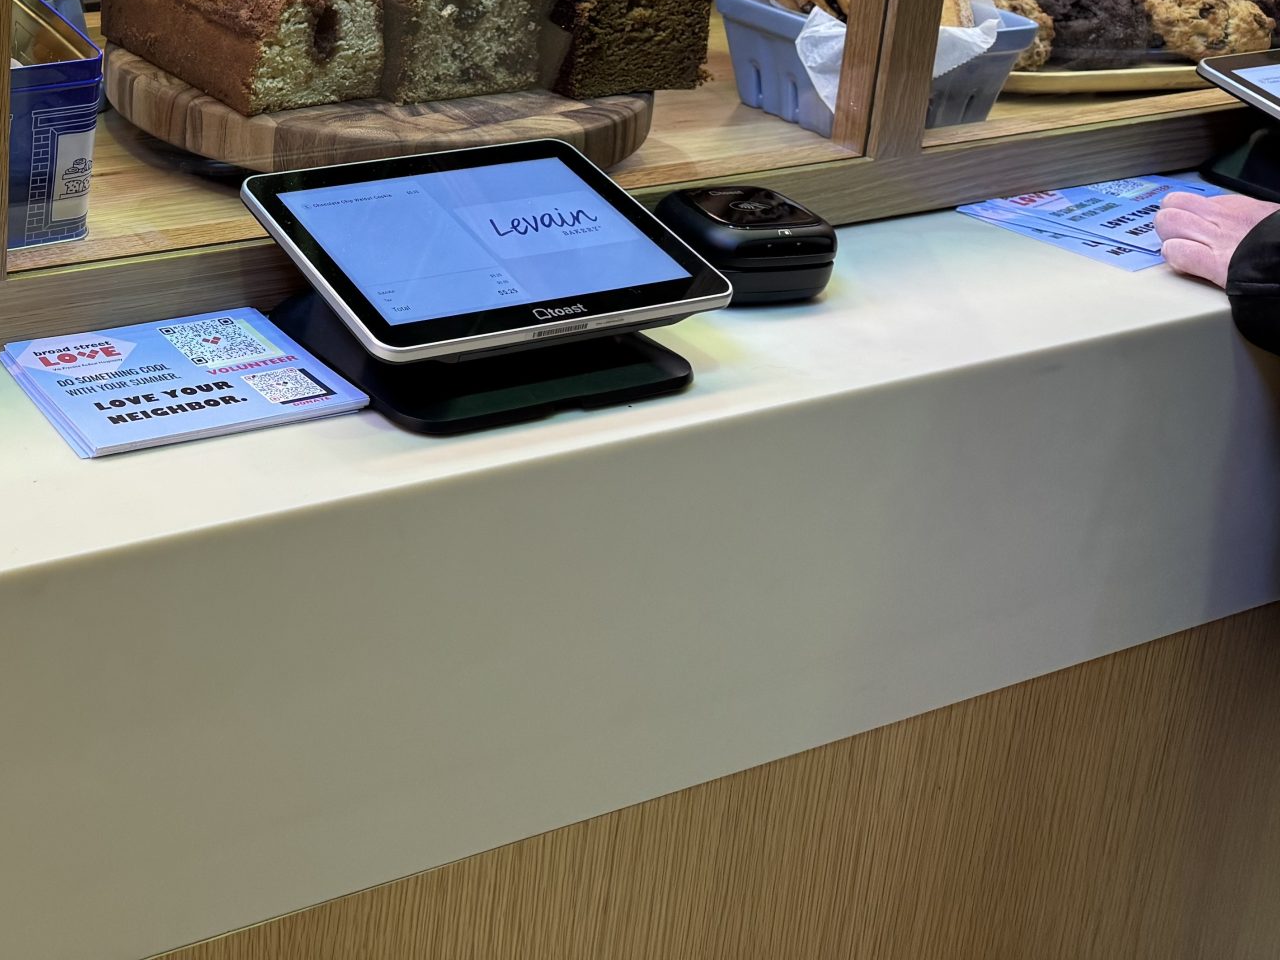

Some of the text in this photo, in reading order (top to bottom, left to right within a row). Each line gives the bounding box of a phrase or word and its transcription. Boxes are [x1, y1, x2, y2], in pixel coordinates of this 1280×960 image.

[489, 207, 598, 237] Levain
[548, 303, 588, 317] toast
[33, 341, 111, 357] broad street
[57, 363, 172, 387] DO SOMETHING COOL
[206, 355, 299, 376] VOLUNTEER
[65, 372, 181, 397] WITH YOUR SUMMER.
[93, 380, 235, 411] LOVE YOUR
[106, 394, 248, 425] NEIGHBOR.
